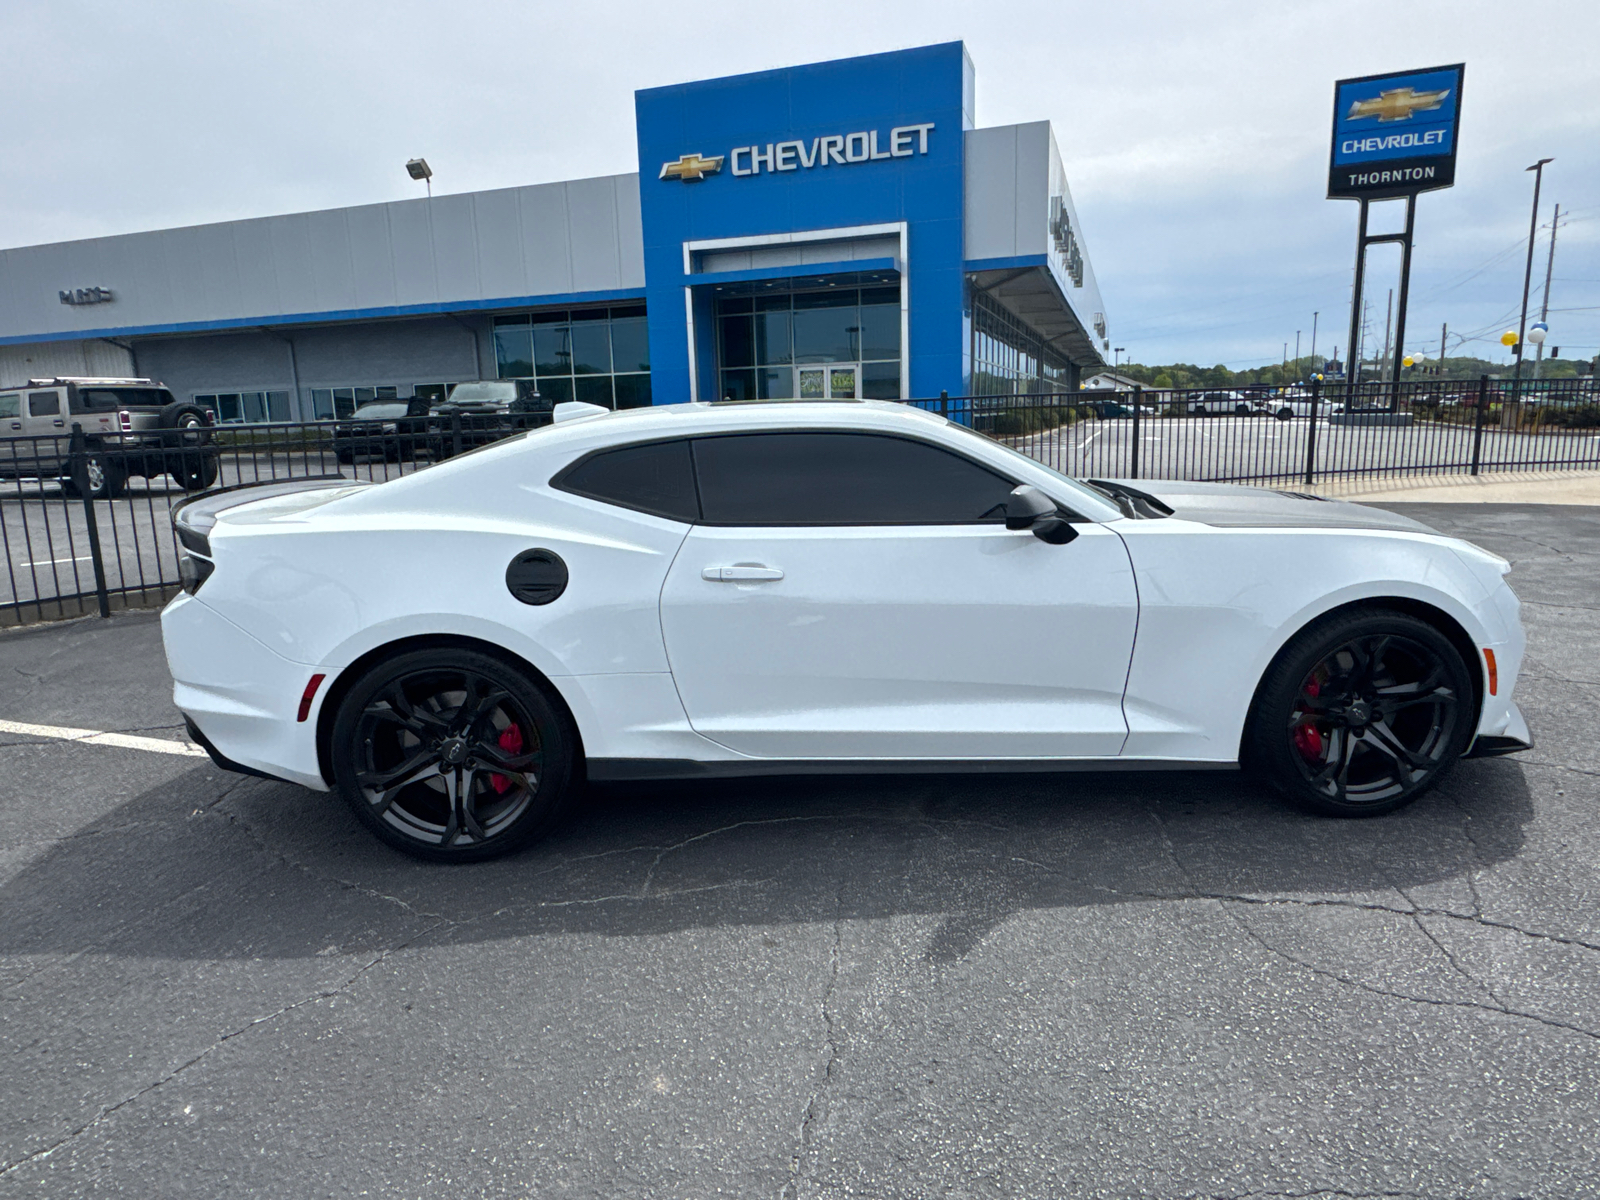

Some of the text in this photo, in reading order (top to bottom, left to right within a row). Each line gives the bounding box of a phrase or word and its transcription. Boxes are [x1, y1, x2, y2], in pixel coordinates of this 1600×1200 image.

[731, 122, 935, 177] CHEVROLET
[1342, 129, 1447, 154] CHEVROLET
[1348, 166, 1435, 186] THORNTON
